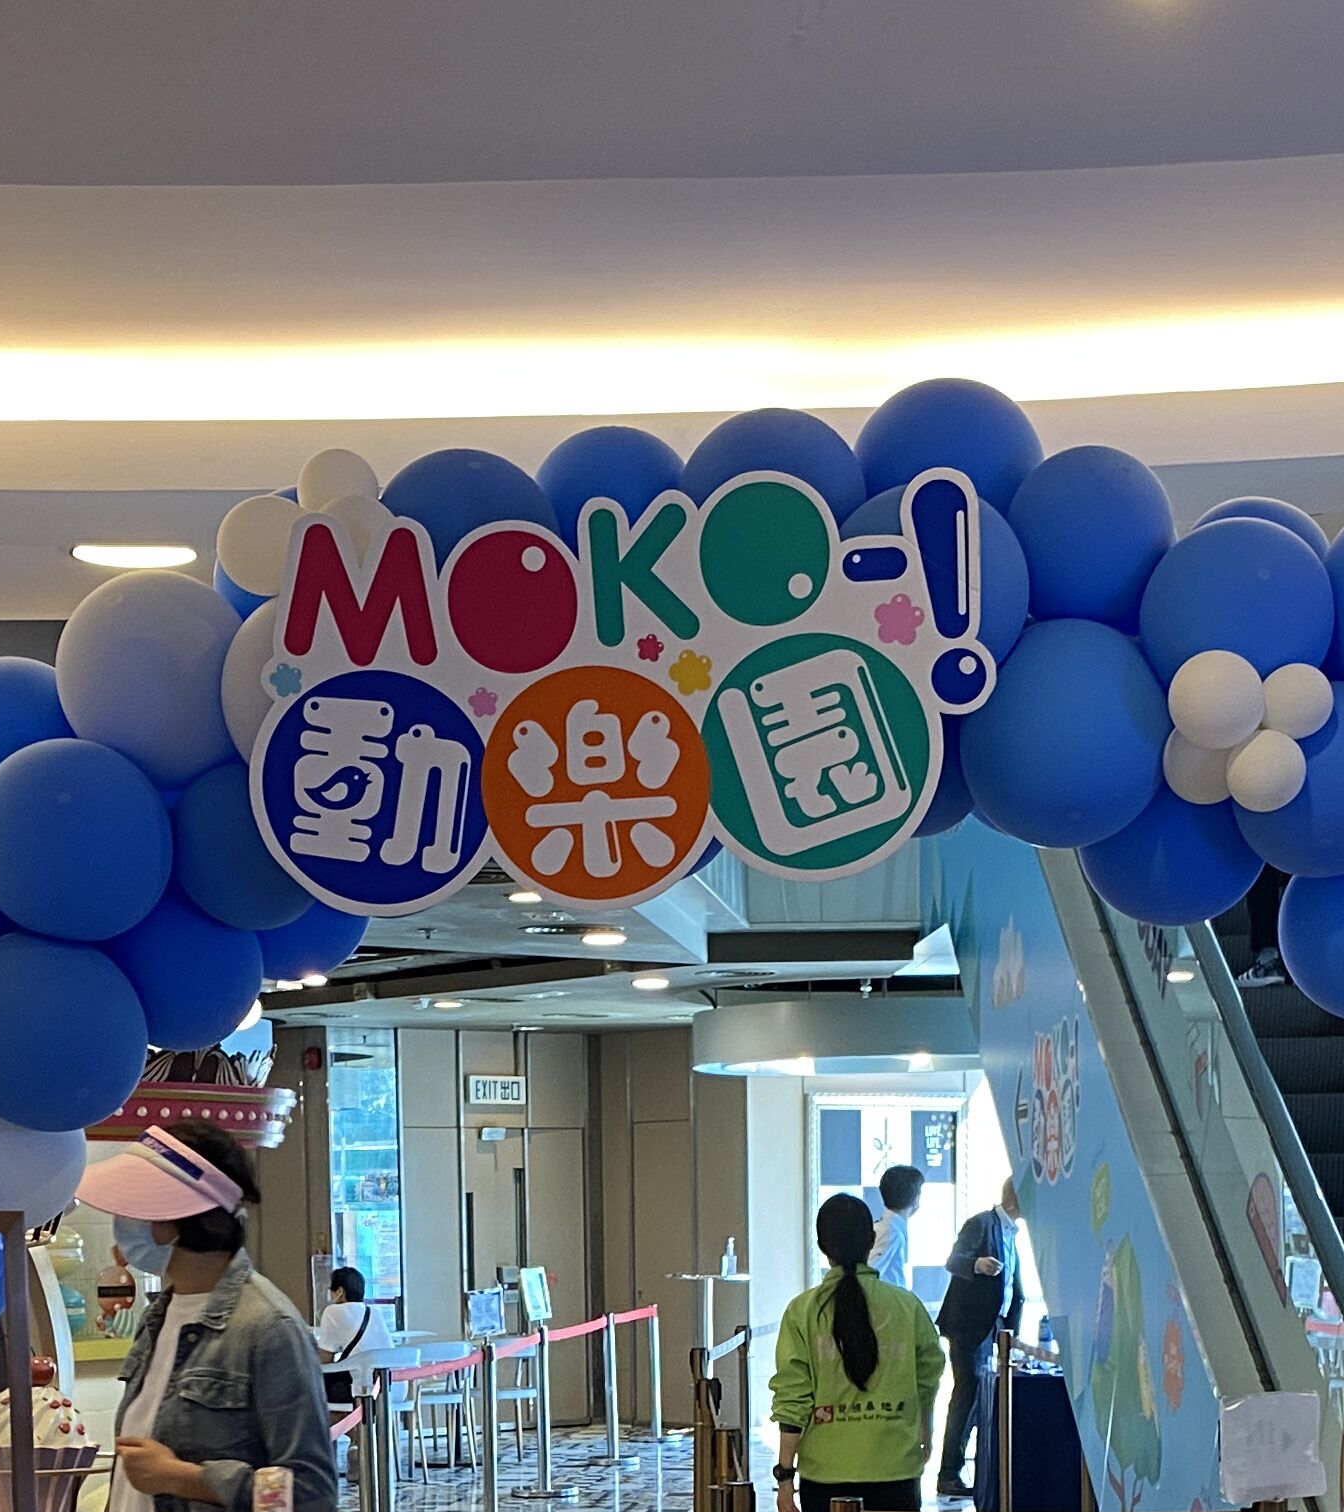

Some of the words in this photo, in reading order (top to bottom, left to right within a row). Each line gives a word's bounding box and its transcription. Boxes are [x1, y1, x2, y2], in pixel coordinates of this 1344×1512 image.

[288, 644, 918, 884] 動樂園
[475, 1080, 498, 1100] EXIT
[500, 1081, 520, 1100] 出口
